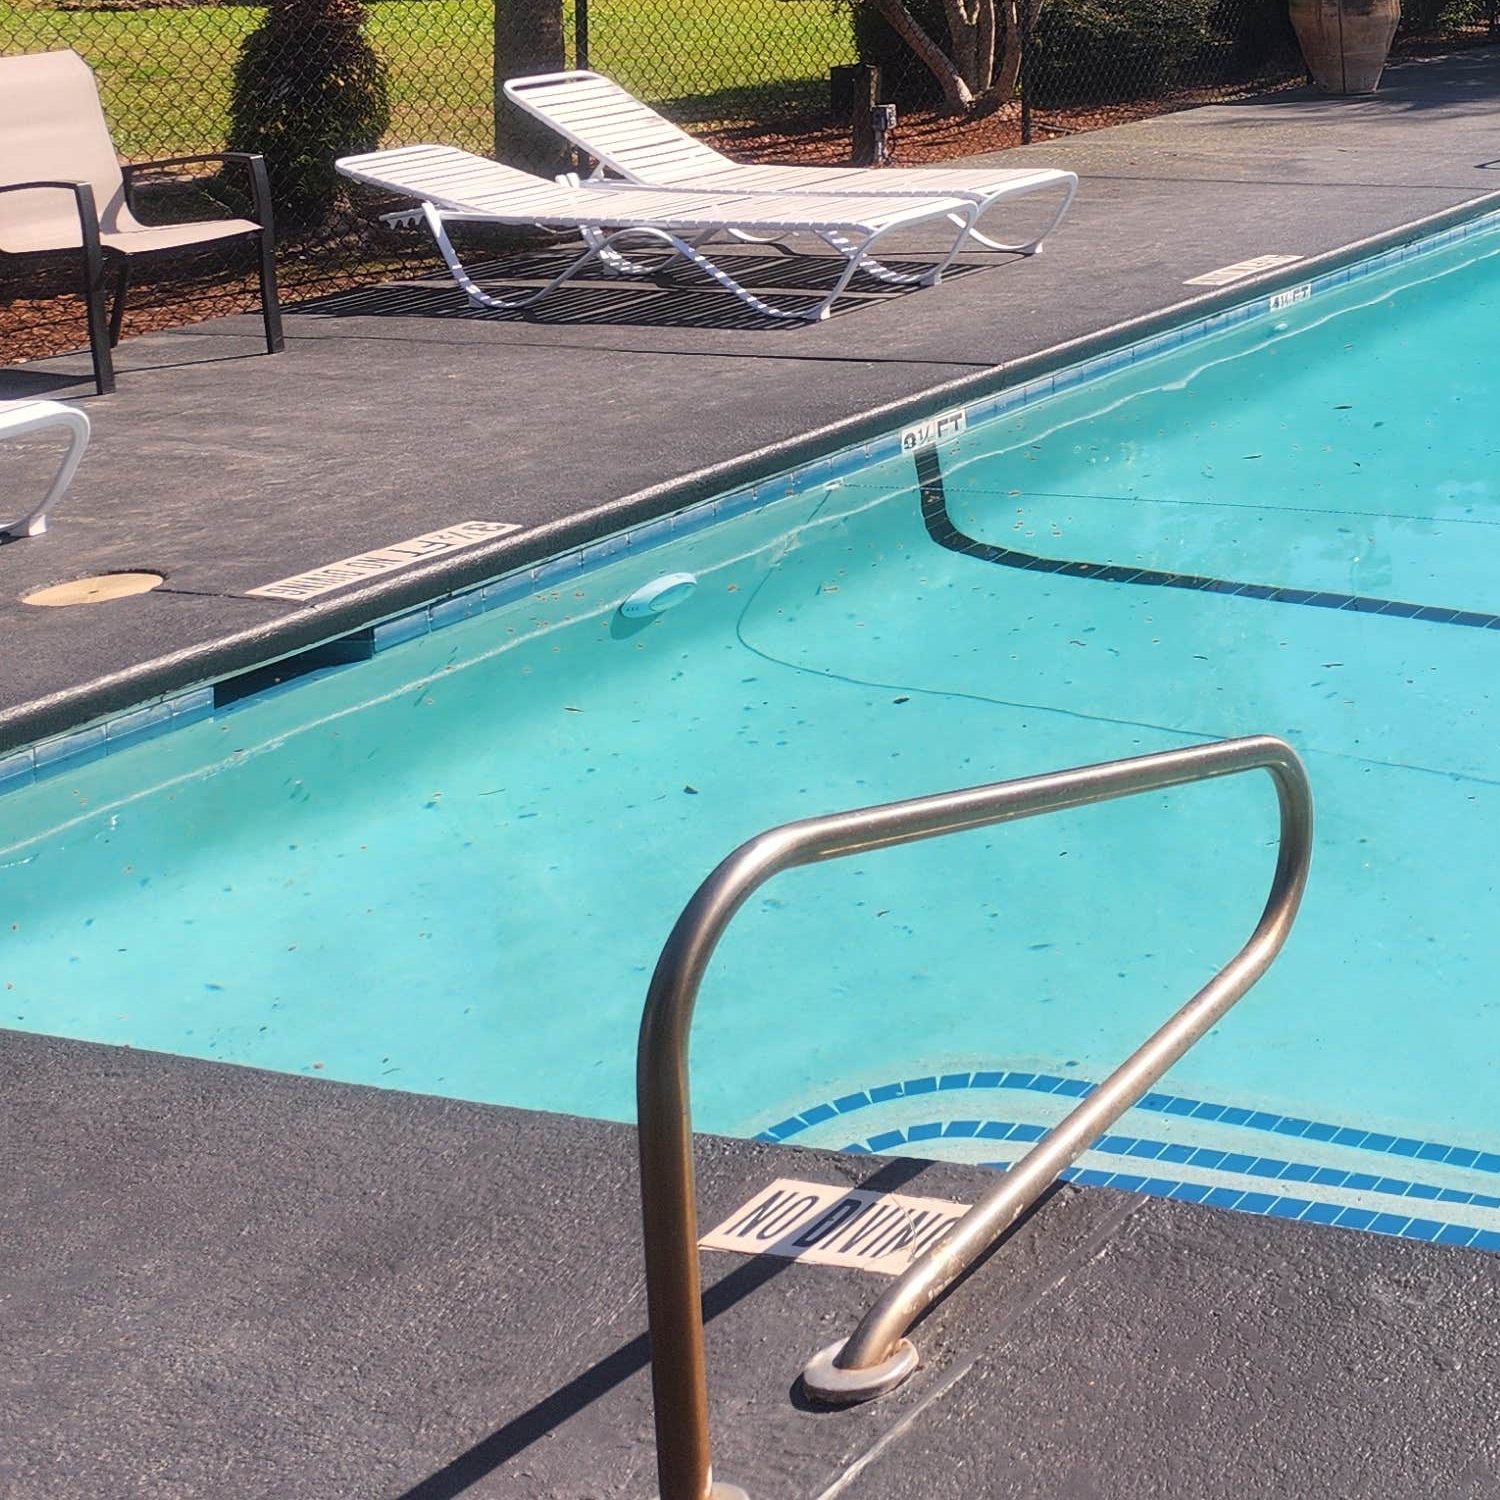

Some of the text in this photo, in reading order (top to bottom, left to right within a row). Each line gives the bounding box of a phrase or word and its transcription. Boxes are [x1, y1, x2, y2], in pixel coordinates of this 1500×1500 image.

[937, 412, 963, 438] FT
[388, 539, 457, 557] FT
[345, 556, 405, 569] NO
[264, 569, 366, 596] DIVING
[724, 1189, 820, 1240] NO
